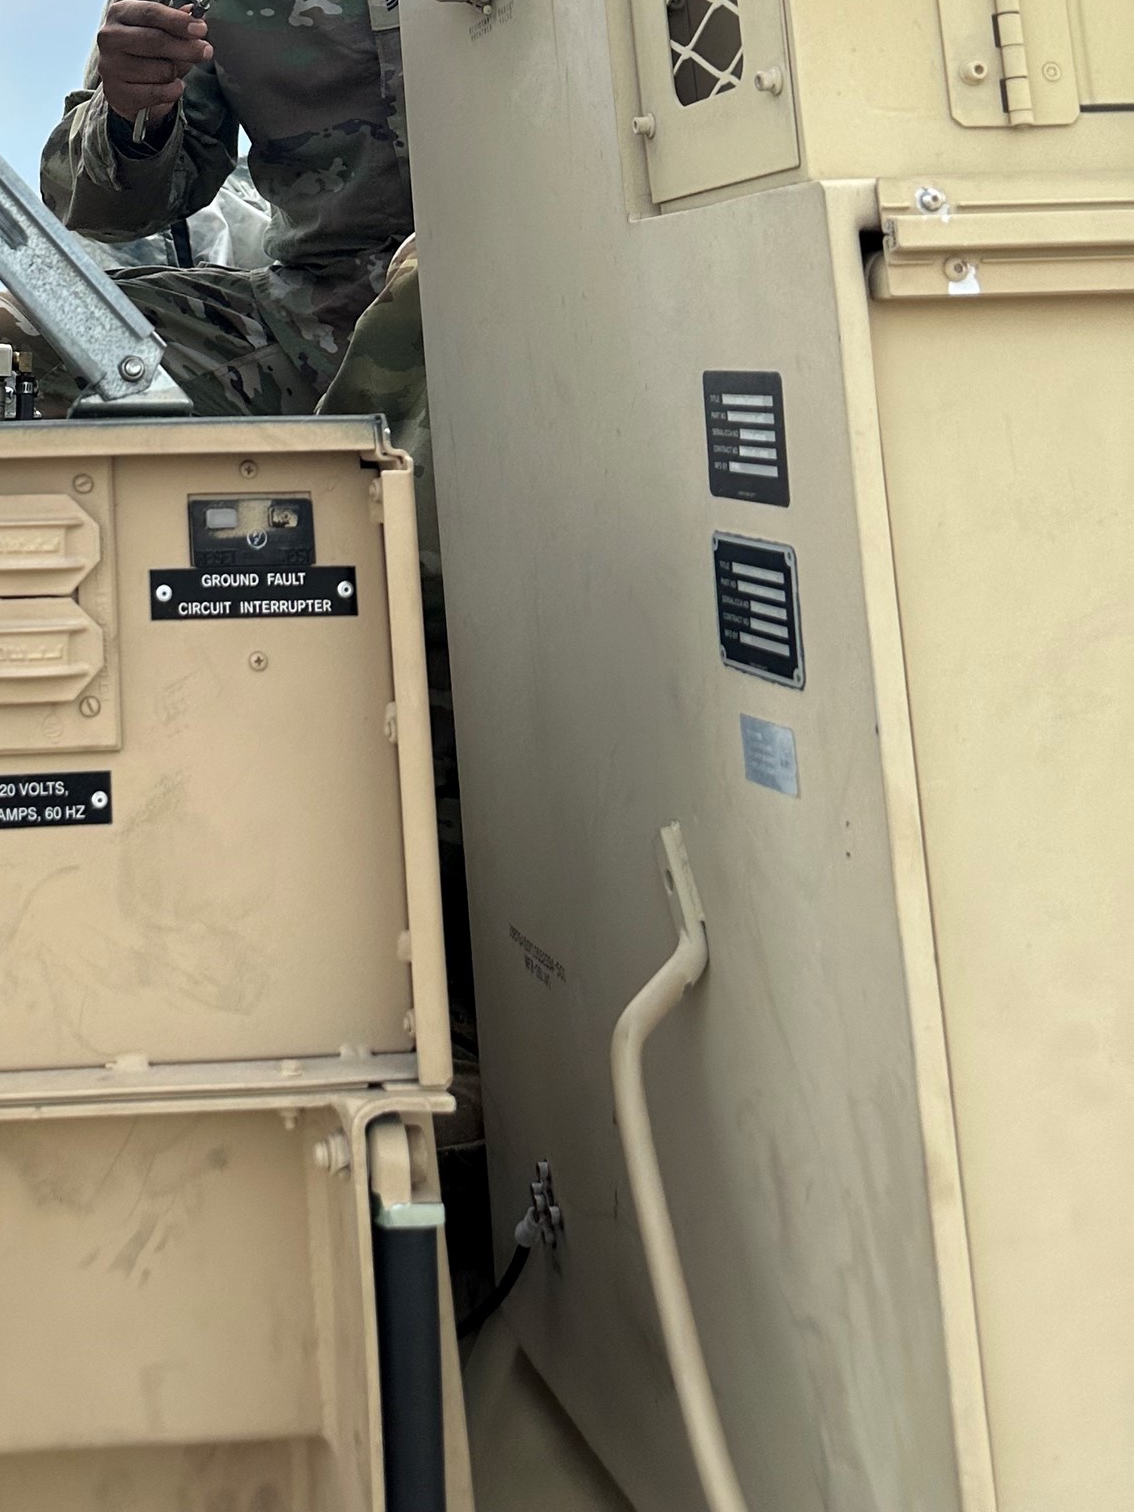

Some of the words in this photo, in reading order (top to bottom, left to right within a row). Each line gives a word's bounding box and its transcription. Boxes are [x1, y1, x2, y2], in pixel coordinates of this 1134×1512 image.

[201, 573, 259, 587] GROUND
[267, 572, 306, 585] FAULT
[178, 601, 232, 615] CIRCUIT
[240, 599, 332, 614] INTERRUPTER
[19, 781, 69, 798] VOLTS,
[44, 806, 62, 819] 60
[66, 804, 86, 818] HZ
